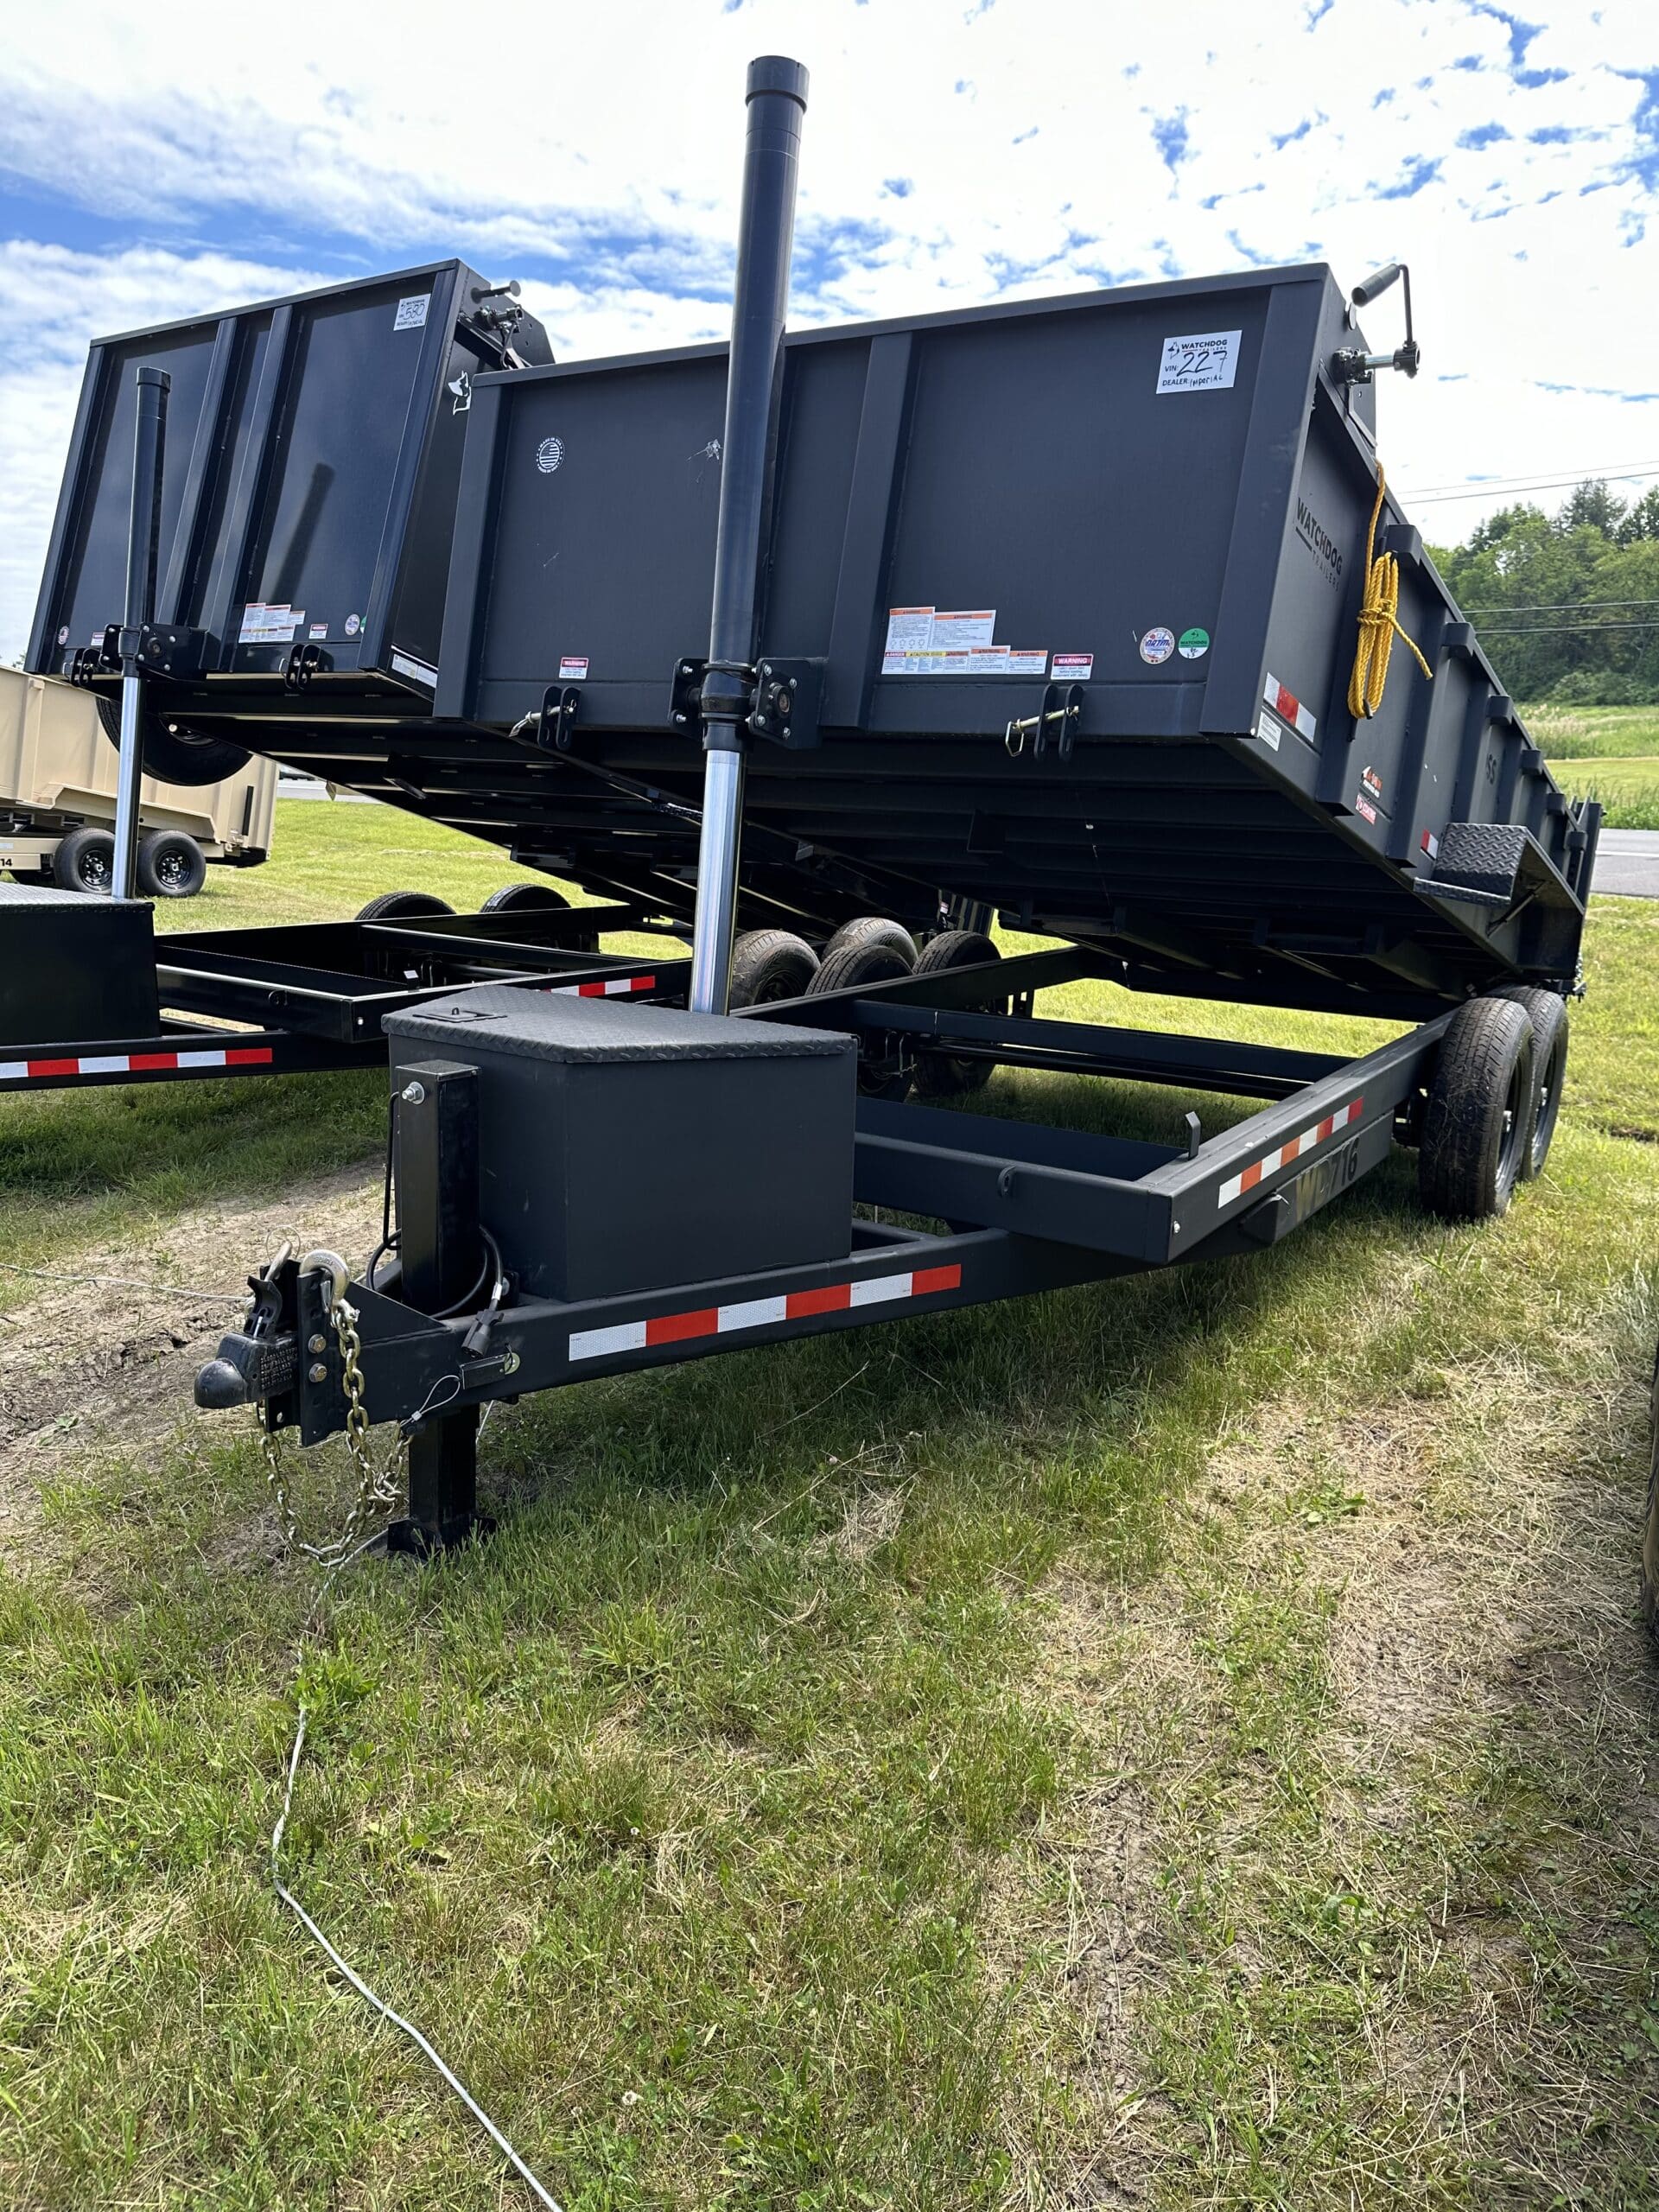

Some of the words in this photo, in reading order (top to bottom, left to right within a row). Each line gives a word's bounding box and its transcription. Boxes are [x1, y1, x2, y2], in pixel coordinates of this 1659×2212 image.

[1181, 340, 1227, 350] WATCHDOG
[1177, 350, 1228, 377] 227
[1297, 497, 1343, 575] WATCHDOG
